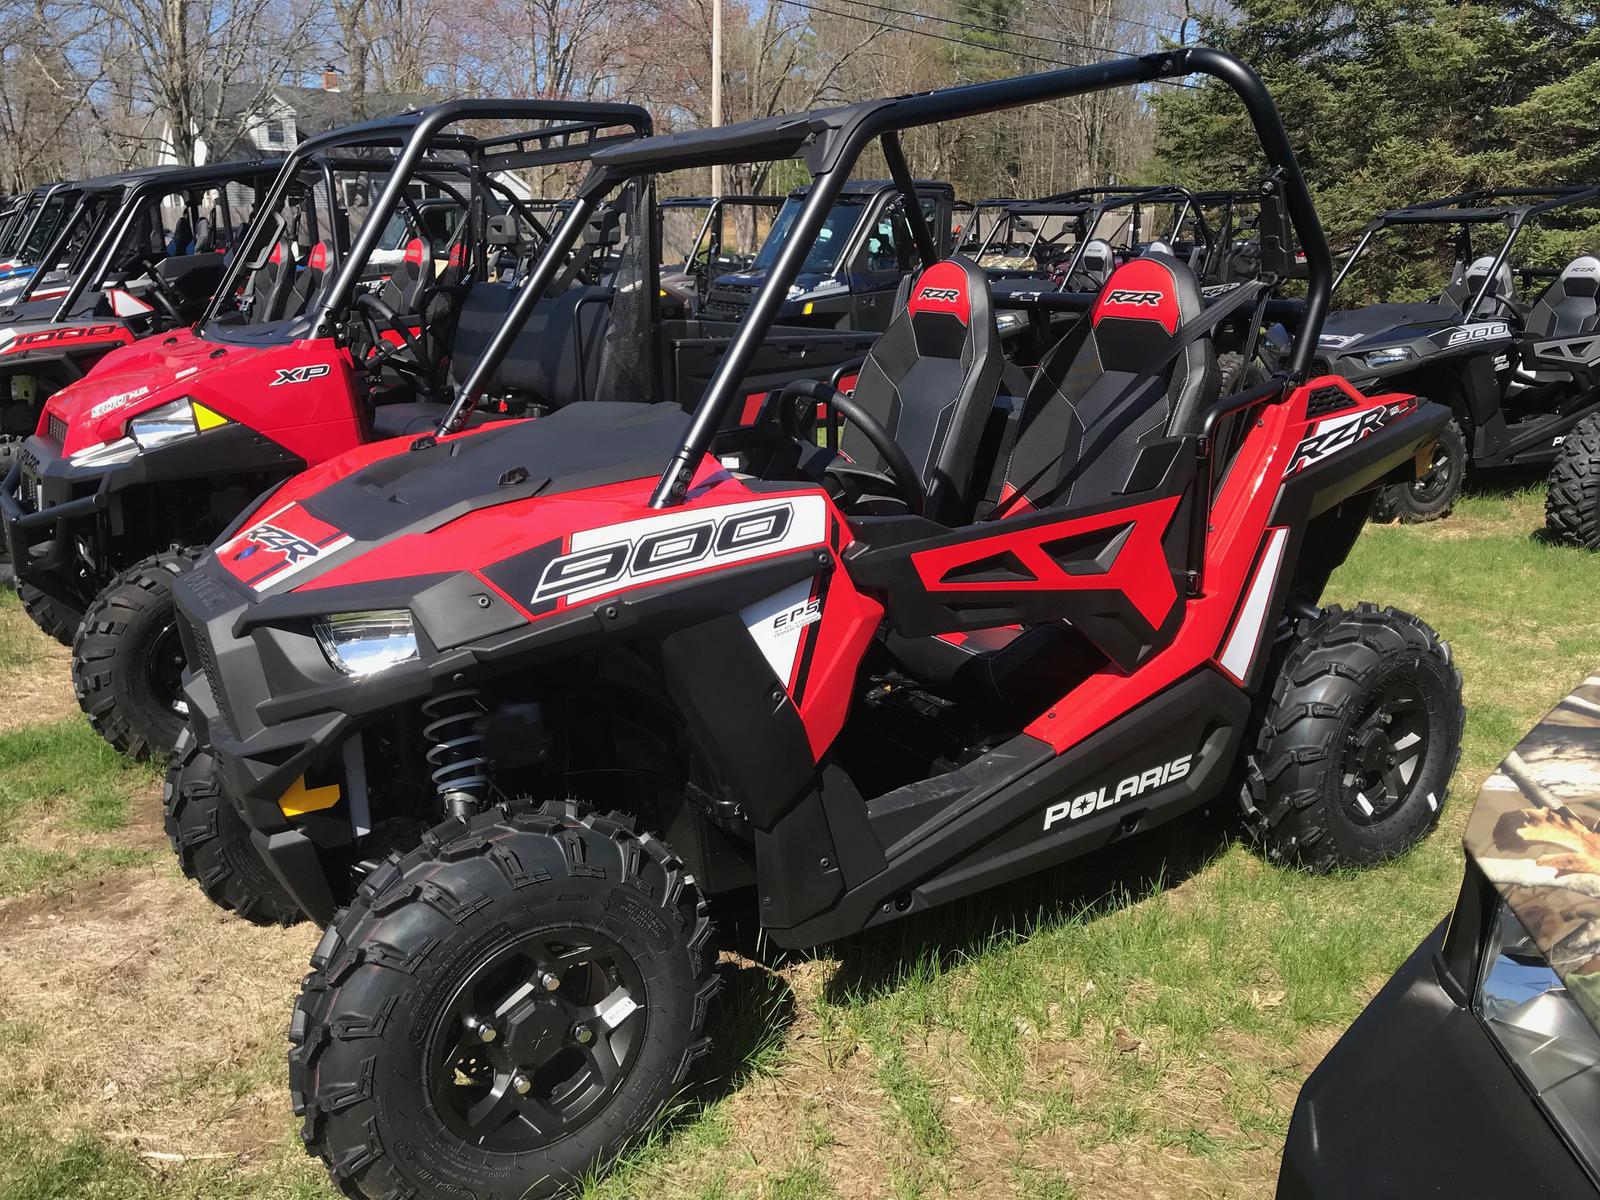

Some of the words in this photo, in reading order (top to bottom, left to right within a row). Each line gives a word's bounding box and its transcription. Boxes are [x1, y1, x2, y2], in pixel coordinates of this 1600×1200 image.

[918, 287, 960, 302] RZR
[1104, 289, 1163, 306] RZR
[1448, 323, 1508, 345] 900
[269, 364, 330, 386] XP
[1281, 405, 1387, 478] RZR
[247, 524, 319, 564] RZR
[531, 501, 795, 604] 900
[773, 600, 820, 629] EPS
[1043, 754, 1193, 831] POLARIS
